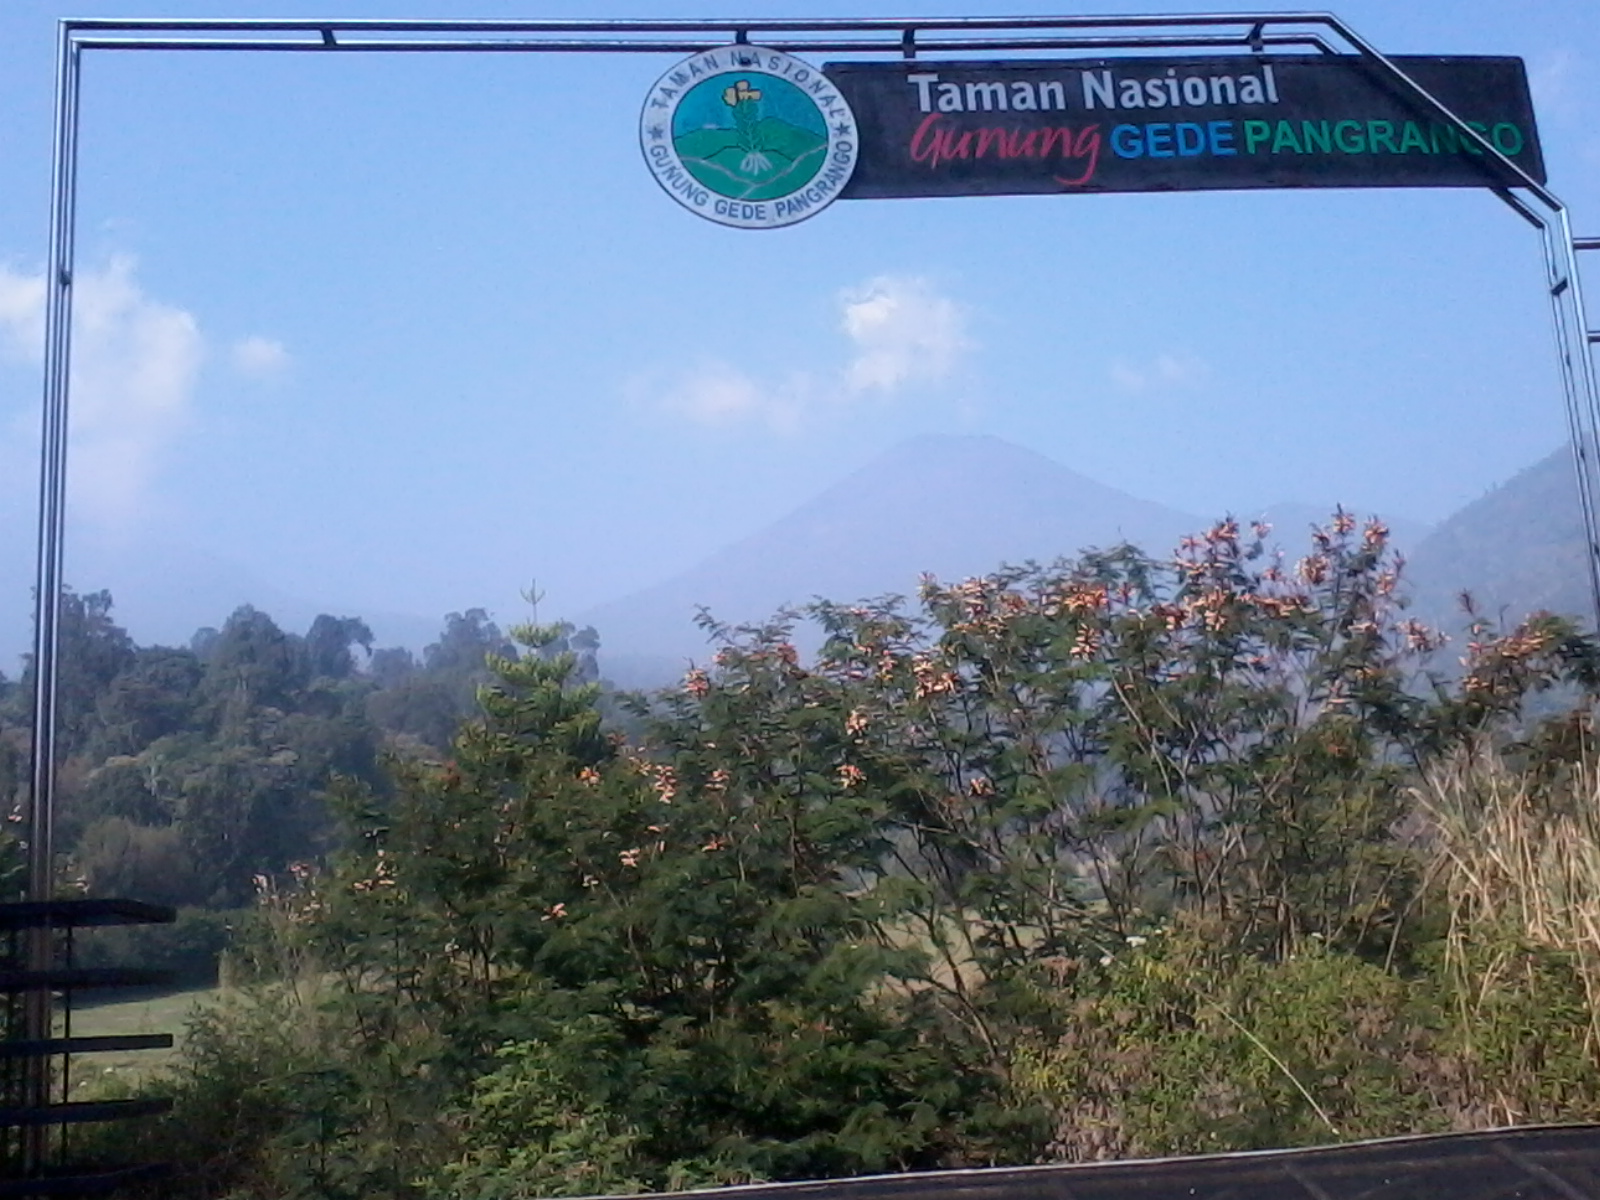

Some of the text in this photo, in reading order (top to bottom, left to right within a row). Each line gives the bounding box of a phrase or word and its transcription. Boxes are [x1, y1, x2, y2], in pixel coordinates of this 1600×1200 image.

[651, 51, 845, 119] TAMAN NASIONAL
[907, 65, 1280, 113] Taman Nasional
[650, 140, 853, 220] GUNUNG GEDE PANGRANGO
[909, 113, 1101, 186] Gunung
[1109, 120, 1238, 159] GEDE
